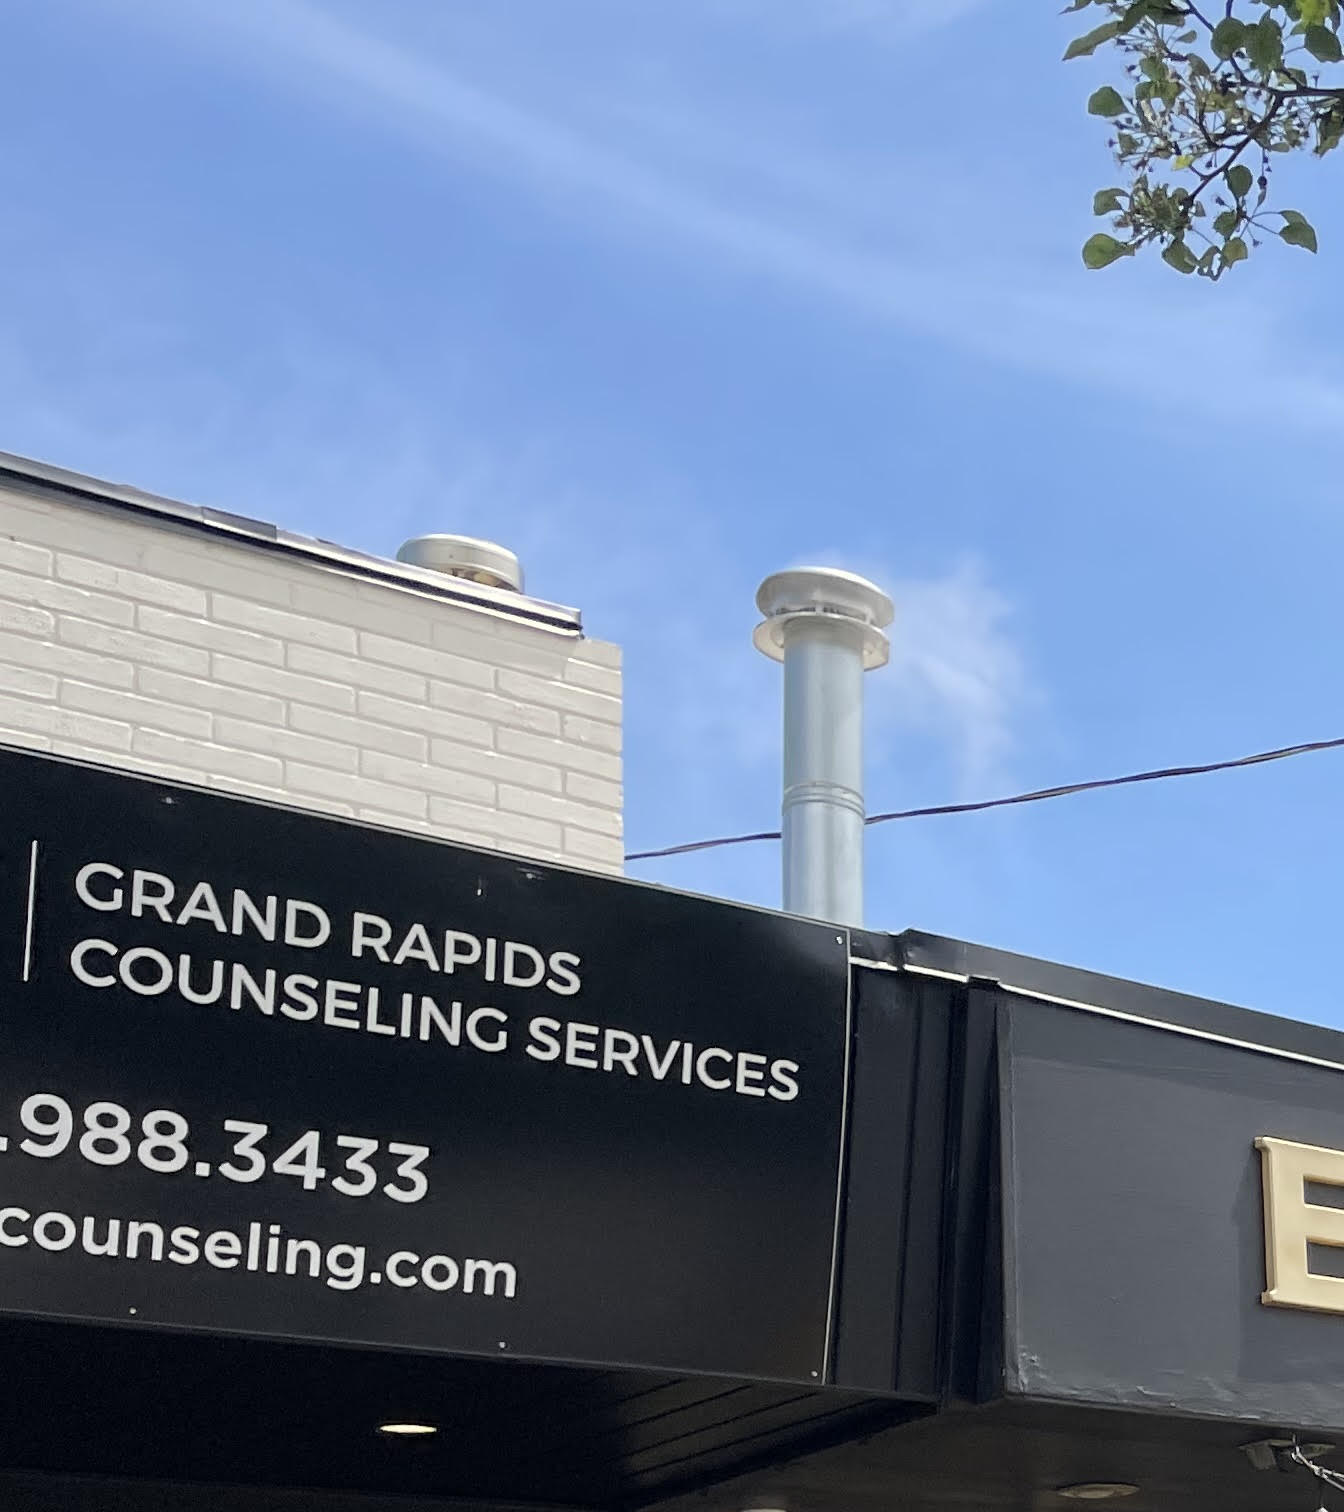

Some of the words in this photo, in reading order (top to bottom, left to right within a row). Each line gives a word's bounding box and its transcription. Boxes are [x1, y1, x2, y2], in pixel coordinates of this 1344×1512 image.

[74, 862, 330, 949] GRAND
[351, 911, 582, 995] RAPIDS
[70, 939, 508, 1052] COUNSELING
[525, 1015, 800, 1101] SERVICES
[0, 1207, 518, 1299] counseling.com
